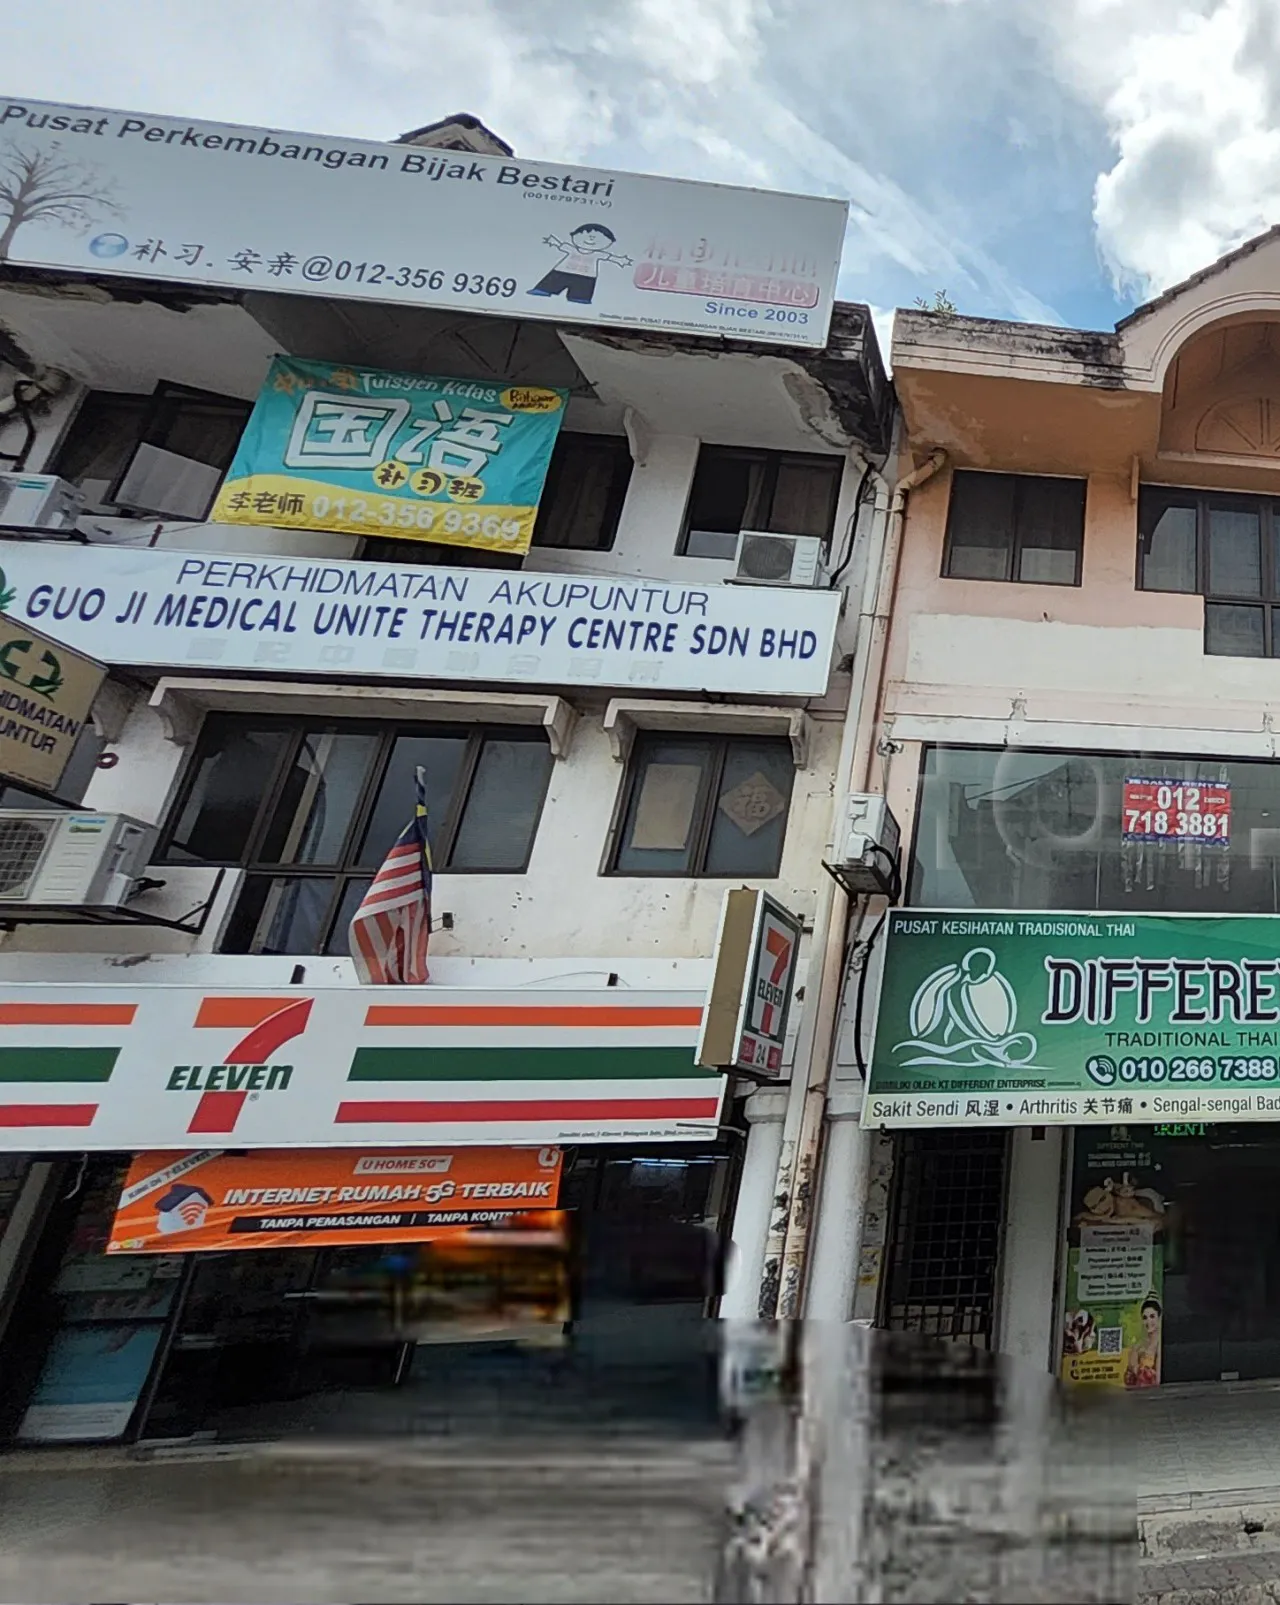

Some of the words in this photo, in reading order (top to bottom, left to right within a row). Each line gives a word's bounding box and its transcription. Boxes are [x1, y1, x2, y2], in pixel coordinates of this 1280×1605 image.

[0, 104, 109, 136] Pusat
[117, 118, 390, 170] Perkembangan
[401, 153, 487, 182] Bijak
[496, 166, 615, 197] Bestari
[452, 274, 517, 297] 9369
[704, 302, 758, 318] Since
[764, 309, 808, 324] 2003
[359, 372, 438, 393] Tuisyen
[442, 381, 497, 404] Kelas
[283, 388, 516, 479] 国语
[376, 461, 484, 501] 补习班
[227, 490, 306, 517] 李老师
[312, 495, 433, 530] 012-356
[442, 505, 521, 543] 9369
[176, 558, 468, 602] PERKHIDMATAN
[488, 579, 710, 617] AKUPUNTUR
[26, 584, 107, 622] GUO
[115, 590, 148, 624] JI
[153, 593, 298, 633] MEDICAL
[313, 602, 409, 638] UNITE
[419, 608, 558, 646] THERAPY
[567, 617, 679, 653] CENTRE
[688, 625, 751, 658] SDN
[759, 629, 818, 660] BHD
[1157, 786, 1200, 811] 012
[1125, 809, 1168, 834] 718
[1175, 811, 1229, 837] 3881
[894, 920, 938, 934] PUSAT
[941, 921, 1014, 936] KESIHATAN
[1018, 922, 1103, 937] TRADISIONAL
[1106, 923, 1135, 937] THAI
[1104, 1032, 1230, 1048] TRADITIONAL
[1236, 1031, 1278, 1047] THAI
[186, 997, 315, 1133] 7
[1121, 1059, 1165, 1080] 010
[1170, 1059, 1214, 1080] 266
[1219, 1058, 1275, 1079] 7388
[951, 1079, 995, 1089] DIFFERENT
[997, 1078, 1046, 1089] ENTERPRISE
[872, 1100, 912, 1118] Sakit
[916, 1100, 960, 1117] Sendi
[964, 1099, 1001, 1117] 风湿
[1019, 1098, 1078, 1116] Arthritis
[1083, 1097, 1133, 1115] 关节痛
[1153, 1096, 1252, 1115] Sengal-sengal
[374, 1159, 416, 1170] HOME
[222, 1187, 339, 1206] INTERNET
[337, 1183, 422, 1202] RUMAH
[424, 1180, 456, 1203] 5G
[461, 1181, 554, 1199] TERBAIK
[260, 1217, 304, 1229] TANPA
[305, 1214, 401, 1228] PEMASANGAN
[427, 1212, 470, 1223] TANPA
